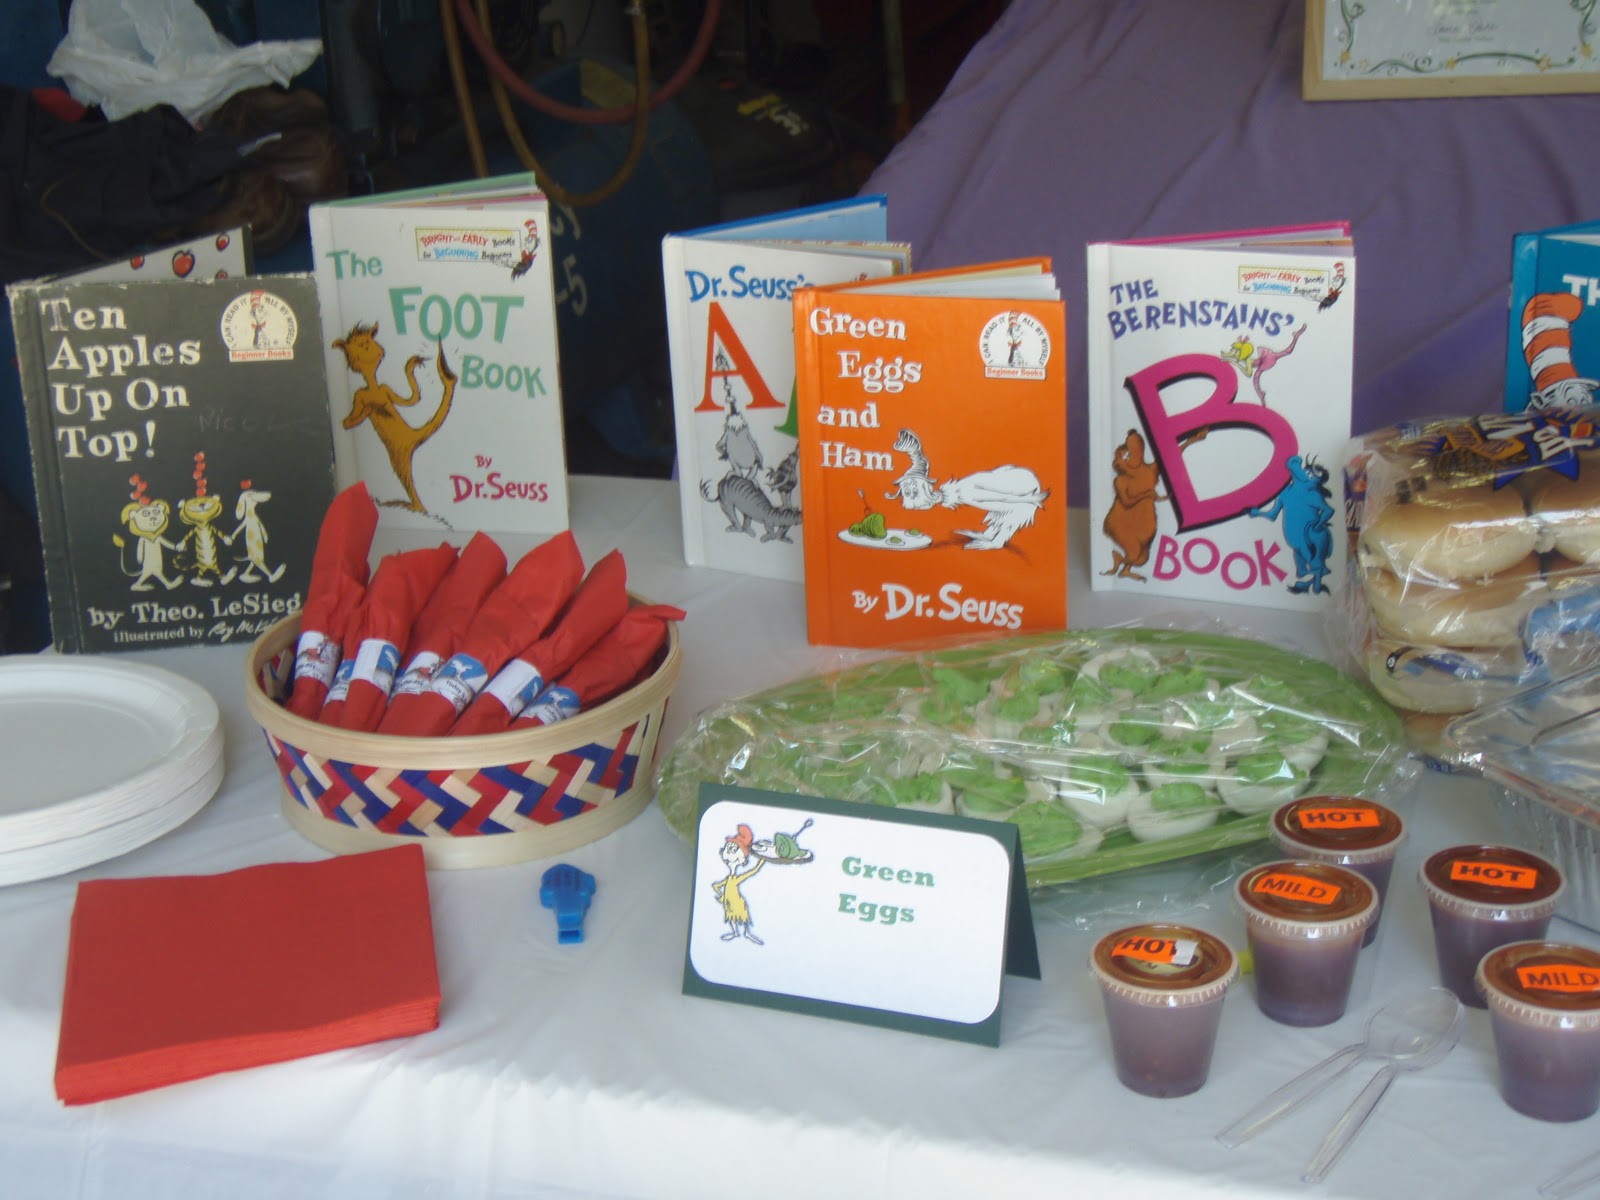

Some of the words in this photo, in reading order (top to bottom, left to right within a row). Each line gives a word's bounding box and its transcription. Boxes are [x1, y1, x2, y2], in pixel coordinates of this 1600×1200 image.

[420, 233, 453, 247] BRIGHT
[461, 233, 489, 247] EARLY
[326, 250, 383, 280] The
[1277, 272, 1301, 284] EARLY
[684, 270, 727, 303] Dr.
[729, 265, 816, 301] Seuss'
[1110, 278, 1159, 305] THE
[41, 297, 127, 332] Ten
[225, 305, 239, 324] READ
[265, 297, 278, 308] ALL
[279, 306, 289, 316] BY
[388, 286, 525, 344] FOOT
[285, 317, 295, 345] MYSELF
[810, 307, 907, 341] Green
[984, 322, 997, 339] READ
[998, 316, 1006, 325] IT
[1022, 317, 1035, 329] ALL
[1035, 327, 1044, 336] BY
[1107, 300, 1295, 340] BERENSTAINS'
[224, 327, 234, 343] CAN
[47, 334, 201, 378] Apples
[231, 350, 265, 360] Beginner
[267, 350, 292, 359] Books
[983, 343, 991, 358] CAN
[1039, 338, 1048, 366] MYSELF
[460, 354, 547, 399] BOOK
[837, 350, 923, 393] Eggs
[987, 367, 1019, 377] Beginner
[1021, 368, 1043, 377] Books
[51, 382, 113, 422] Up
[126, 378, 190, 411] On
[816, 402, 881, 429] and
[57, 420, 157, 463] Top!
[1123, 353, 1299, 535] B
[474, 454, 493, 469] By
[819, 441, 894, 471] Ham
[449, 474, 488, 504] Dr.
[487, 472, 549, 503] Seuss
[1152, 534, 1288, 591] BOOK
[88, 607, 124, 629] by
[131, 602, 204, 625] Theo.
[852, 589, 879, 614] By
[881, 582, 935, 621] Dr.
[938, 582, 1025, 630] Seuss
[113, 627, 185, 643] illustrated
[189, 626, 204, 639] by
[1305, 810, 1365, 825] HOT
[841, 856, 936, 888] Green
[1459, 865, 1525, 882] HOT
[1262, 878, 1327, 900] MILD
[838, 893, 915, 926] Eggs
[1526, 972, 1600, 987] MILD
